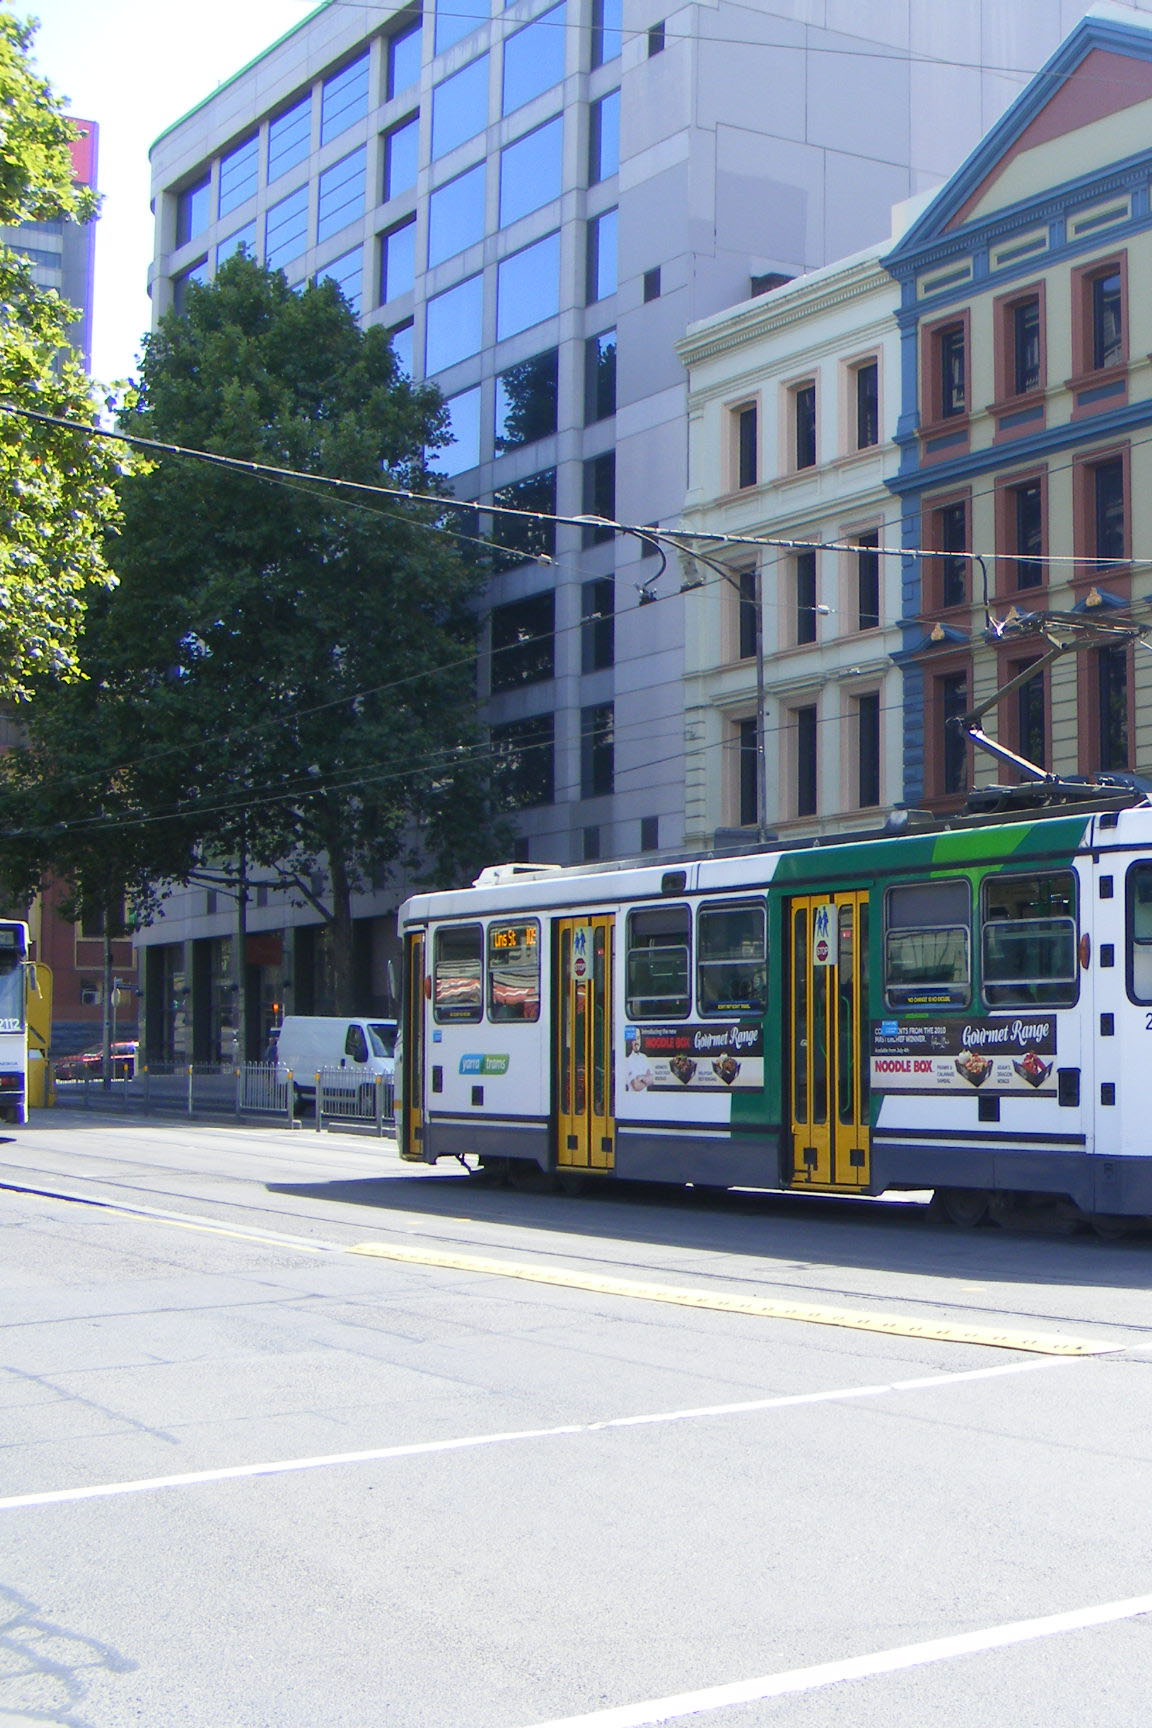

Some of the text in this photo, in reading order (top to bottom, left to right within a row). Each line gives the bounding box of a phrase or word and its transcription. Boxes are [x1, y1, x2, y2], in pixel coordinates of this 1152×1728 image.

[816, 946, 828, 956] STOP
[694, 1026, 758, 1050] Gourmet Range
[962, 1025, 1009, 1047] Gourmet
[1010, 1020, 1050, 1046] Range
[645, 1037, 674, 1049] NOODLE
[462, 1056, 506, 1071] yarra trams
[875, 1060, 933, 1073] NOODLE BOX
